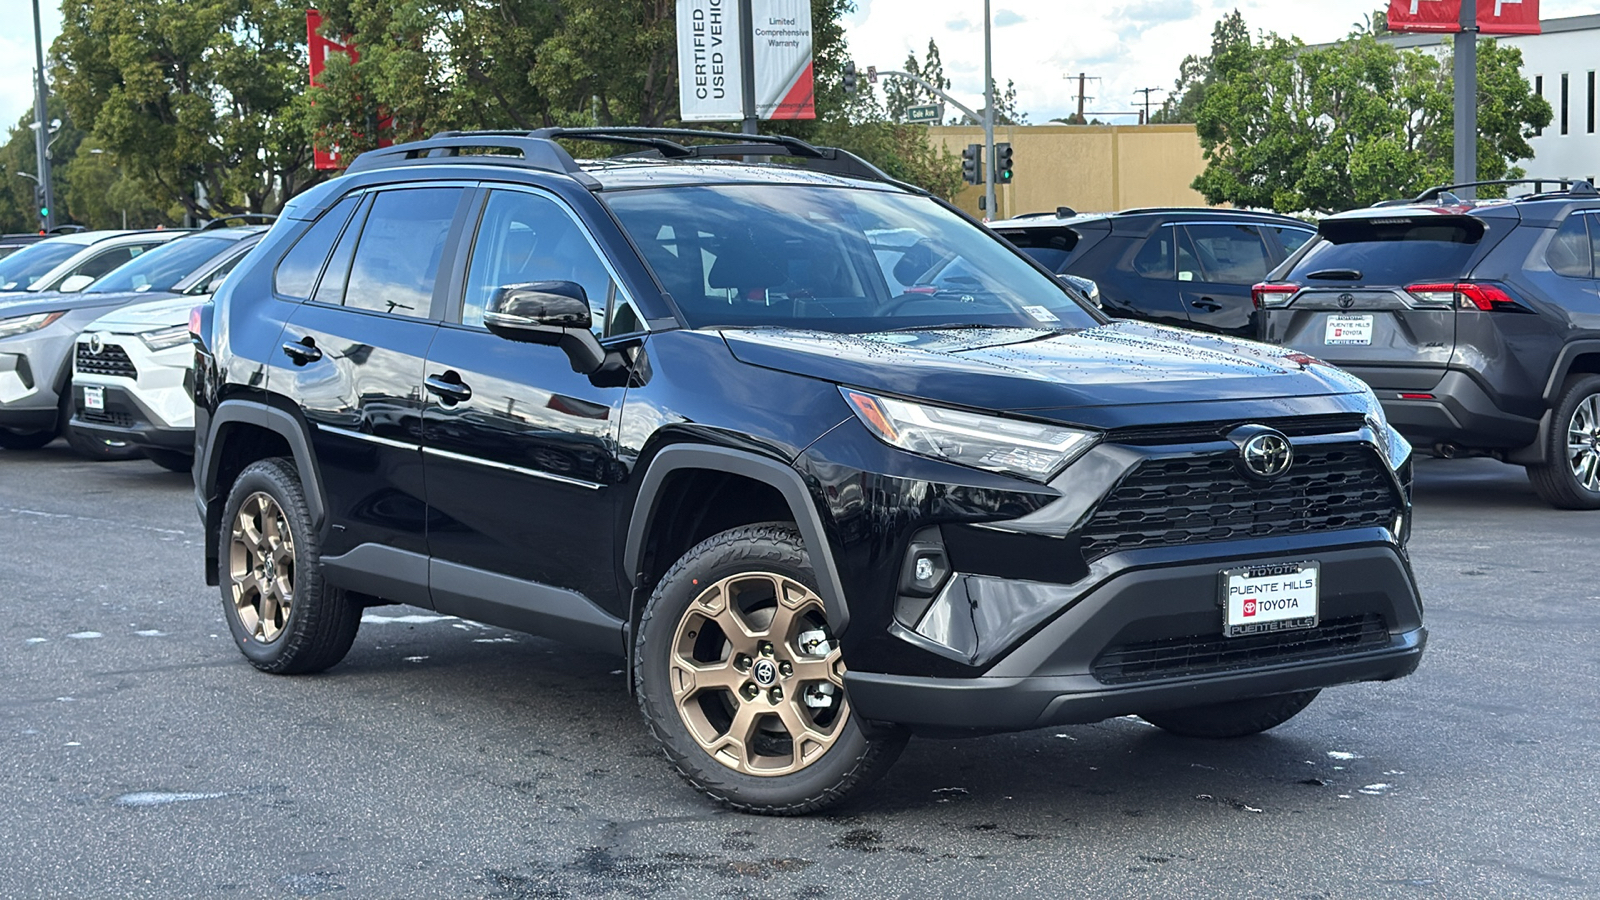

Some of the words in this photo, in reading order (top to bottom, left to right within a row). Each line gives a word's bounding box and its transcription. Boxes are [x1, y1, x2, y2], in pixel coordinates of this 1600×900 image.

[769, 18, 795, 26] Limited
[755, 28, 809, 37] Comprehensive
[768, 40, 799, 49] Warranty
[693, 9, 707, 99] CERTIFIED
[713, 52, 725, 99] USED
[1250, 566, 1297, 577] TOYOTA
[1230, 582, 1279, 596] PUENTE
[1283, 579, 1313, 591] HILLS
[1258, 598, 1299, 612] TOYOTA
[1231, 622, 1278, 634] PUENTE
[1279, 617, 1314, 629] HILLS
